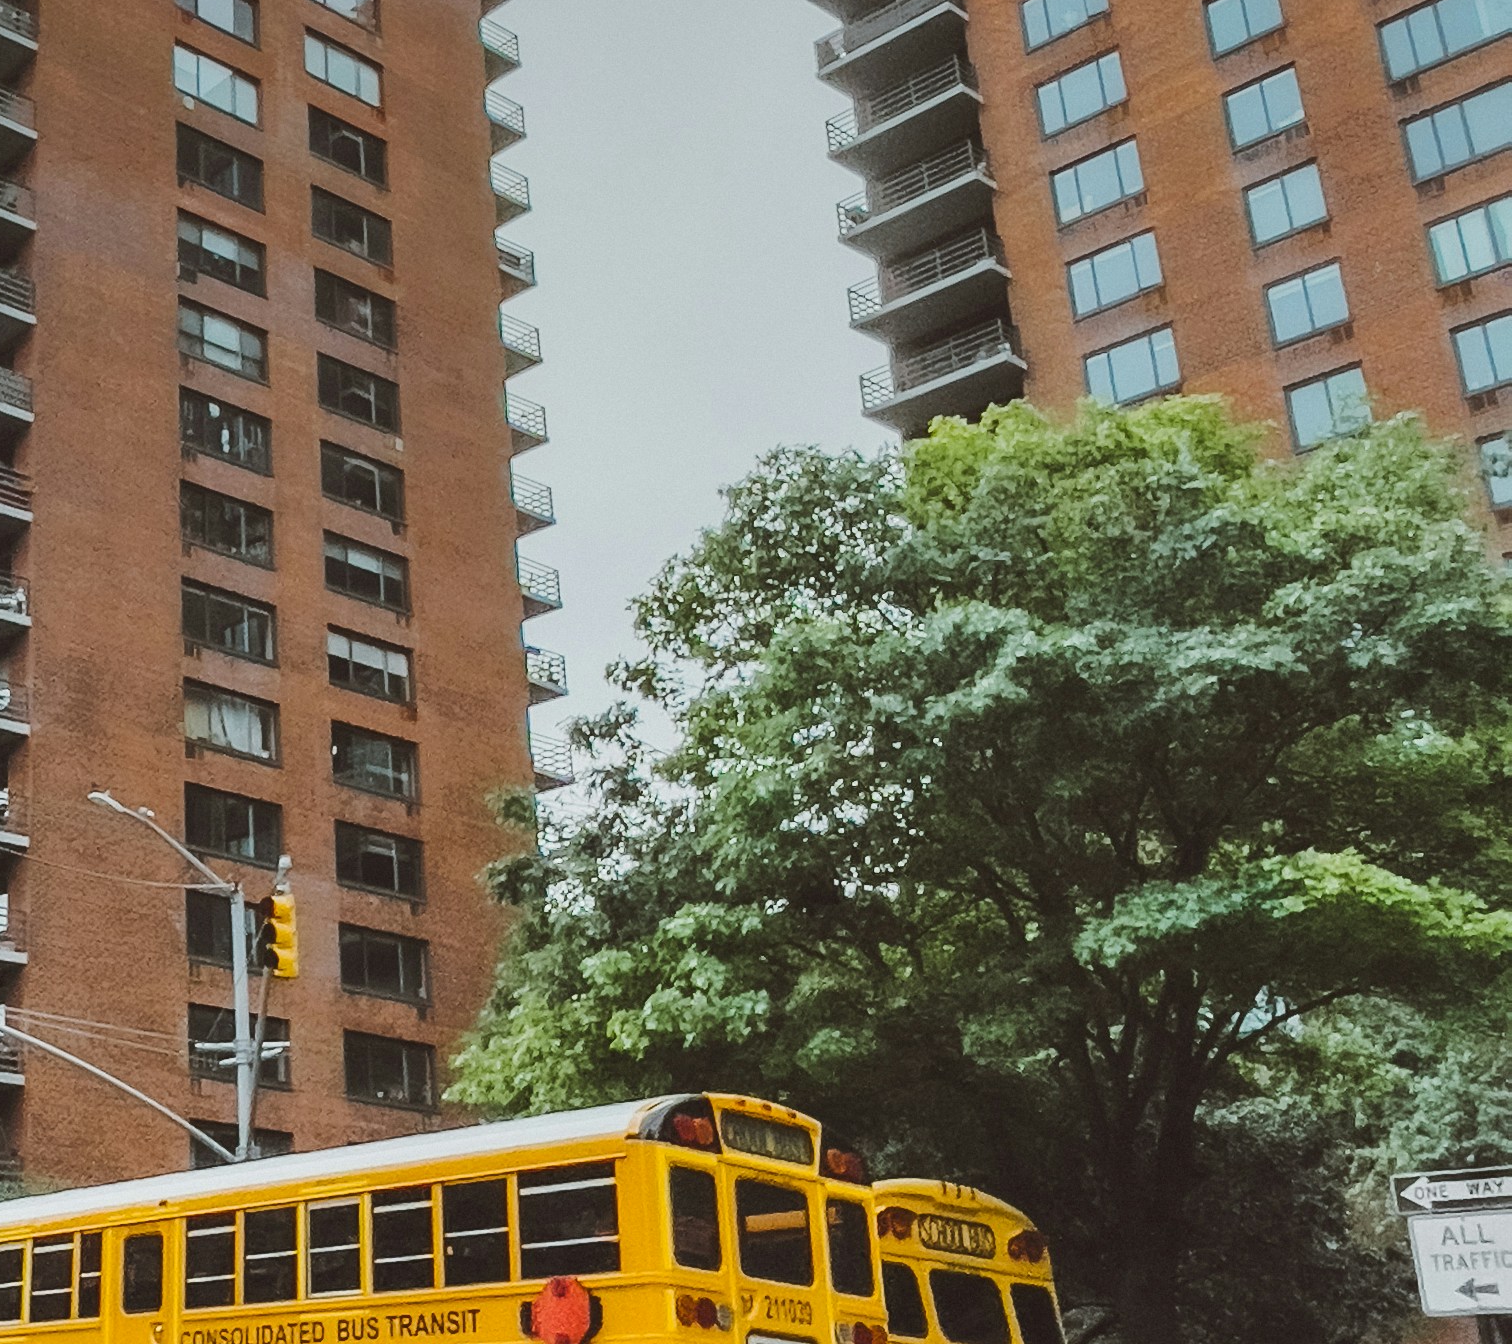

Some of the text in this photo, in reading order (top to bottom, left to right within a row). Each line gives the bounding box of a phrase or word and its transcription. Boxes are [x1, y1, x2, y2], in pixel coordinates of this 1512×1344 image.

[1414, 1178, 1504, 1200] ONE WAY
[1441, 1223, 1495, 1246] ALL
[1430, 1248, 1512, 1273] TRAFFIC
[337, 1316, 380, 1342] BUS
[385, 1308, 481, 1338] TRANSIT
